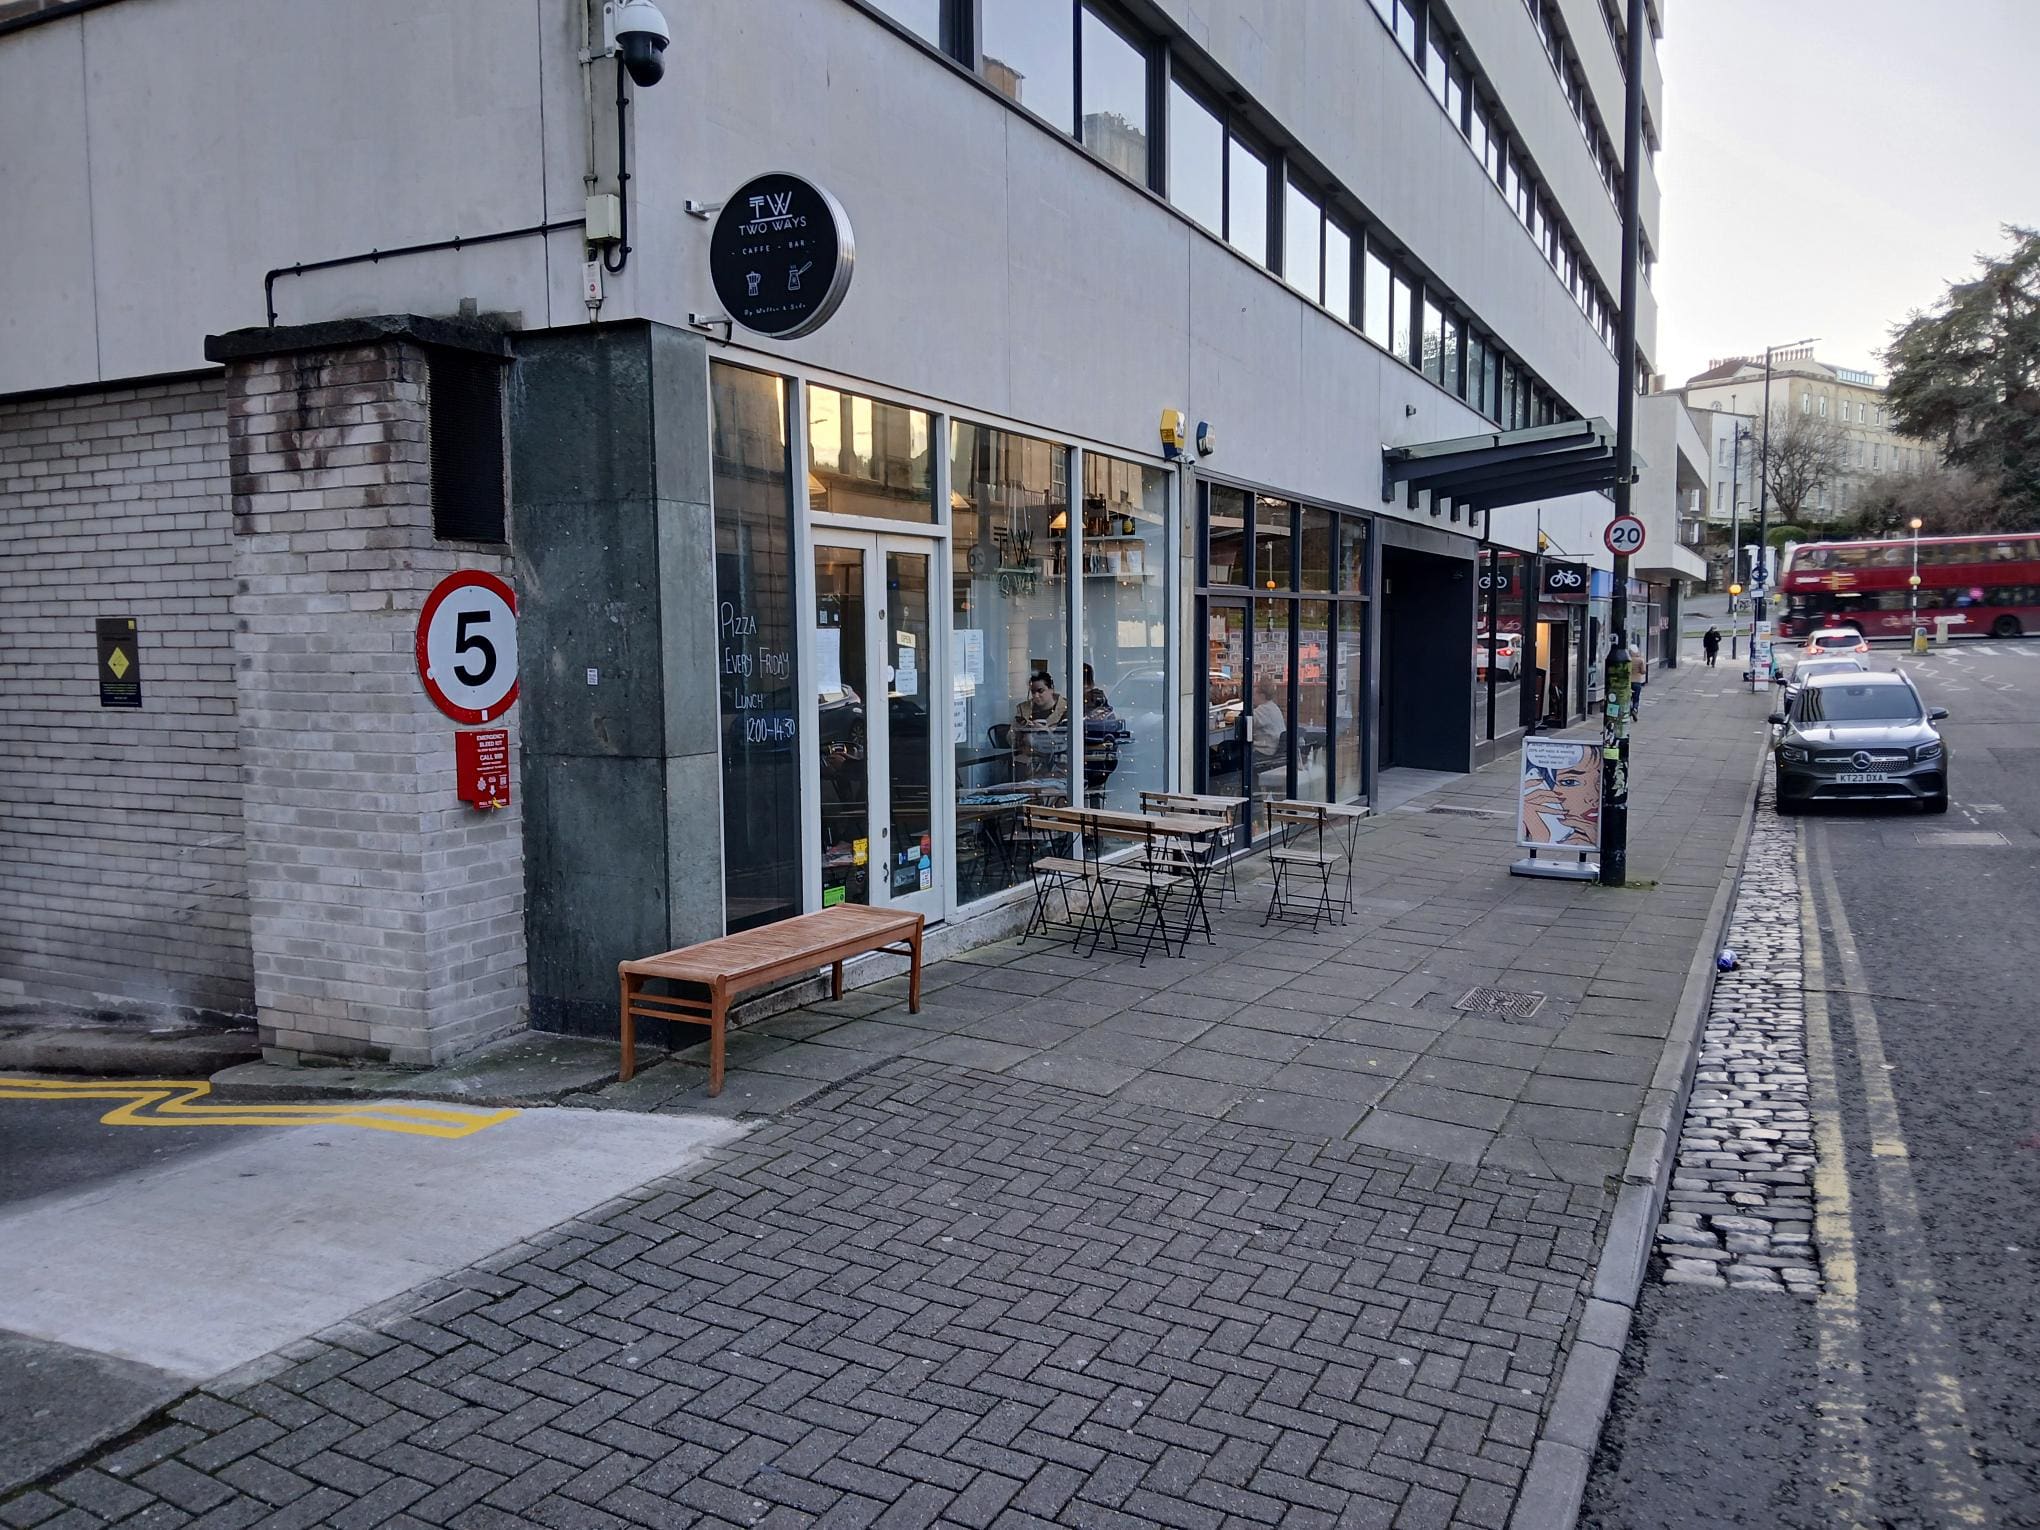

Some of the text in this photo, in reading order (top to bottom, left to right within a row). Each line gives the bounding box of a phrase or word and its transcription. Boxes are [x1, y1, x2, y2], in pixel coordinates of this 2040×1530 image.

[749, 191, 793, 218] TW
[738, 215, 807, 236] TWO WAYS
[742, 239, 805, 255] CAFFE BAR
[1612, 527, 1640, 544] 20
[454, 610, 497, 687] 5
[1840, 774, 1883, 782] KT23 DXA
